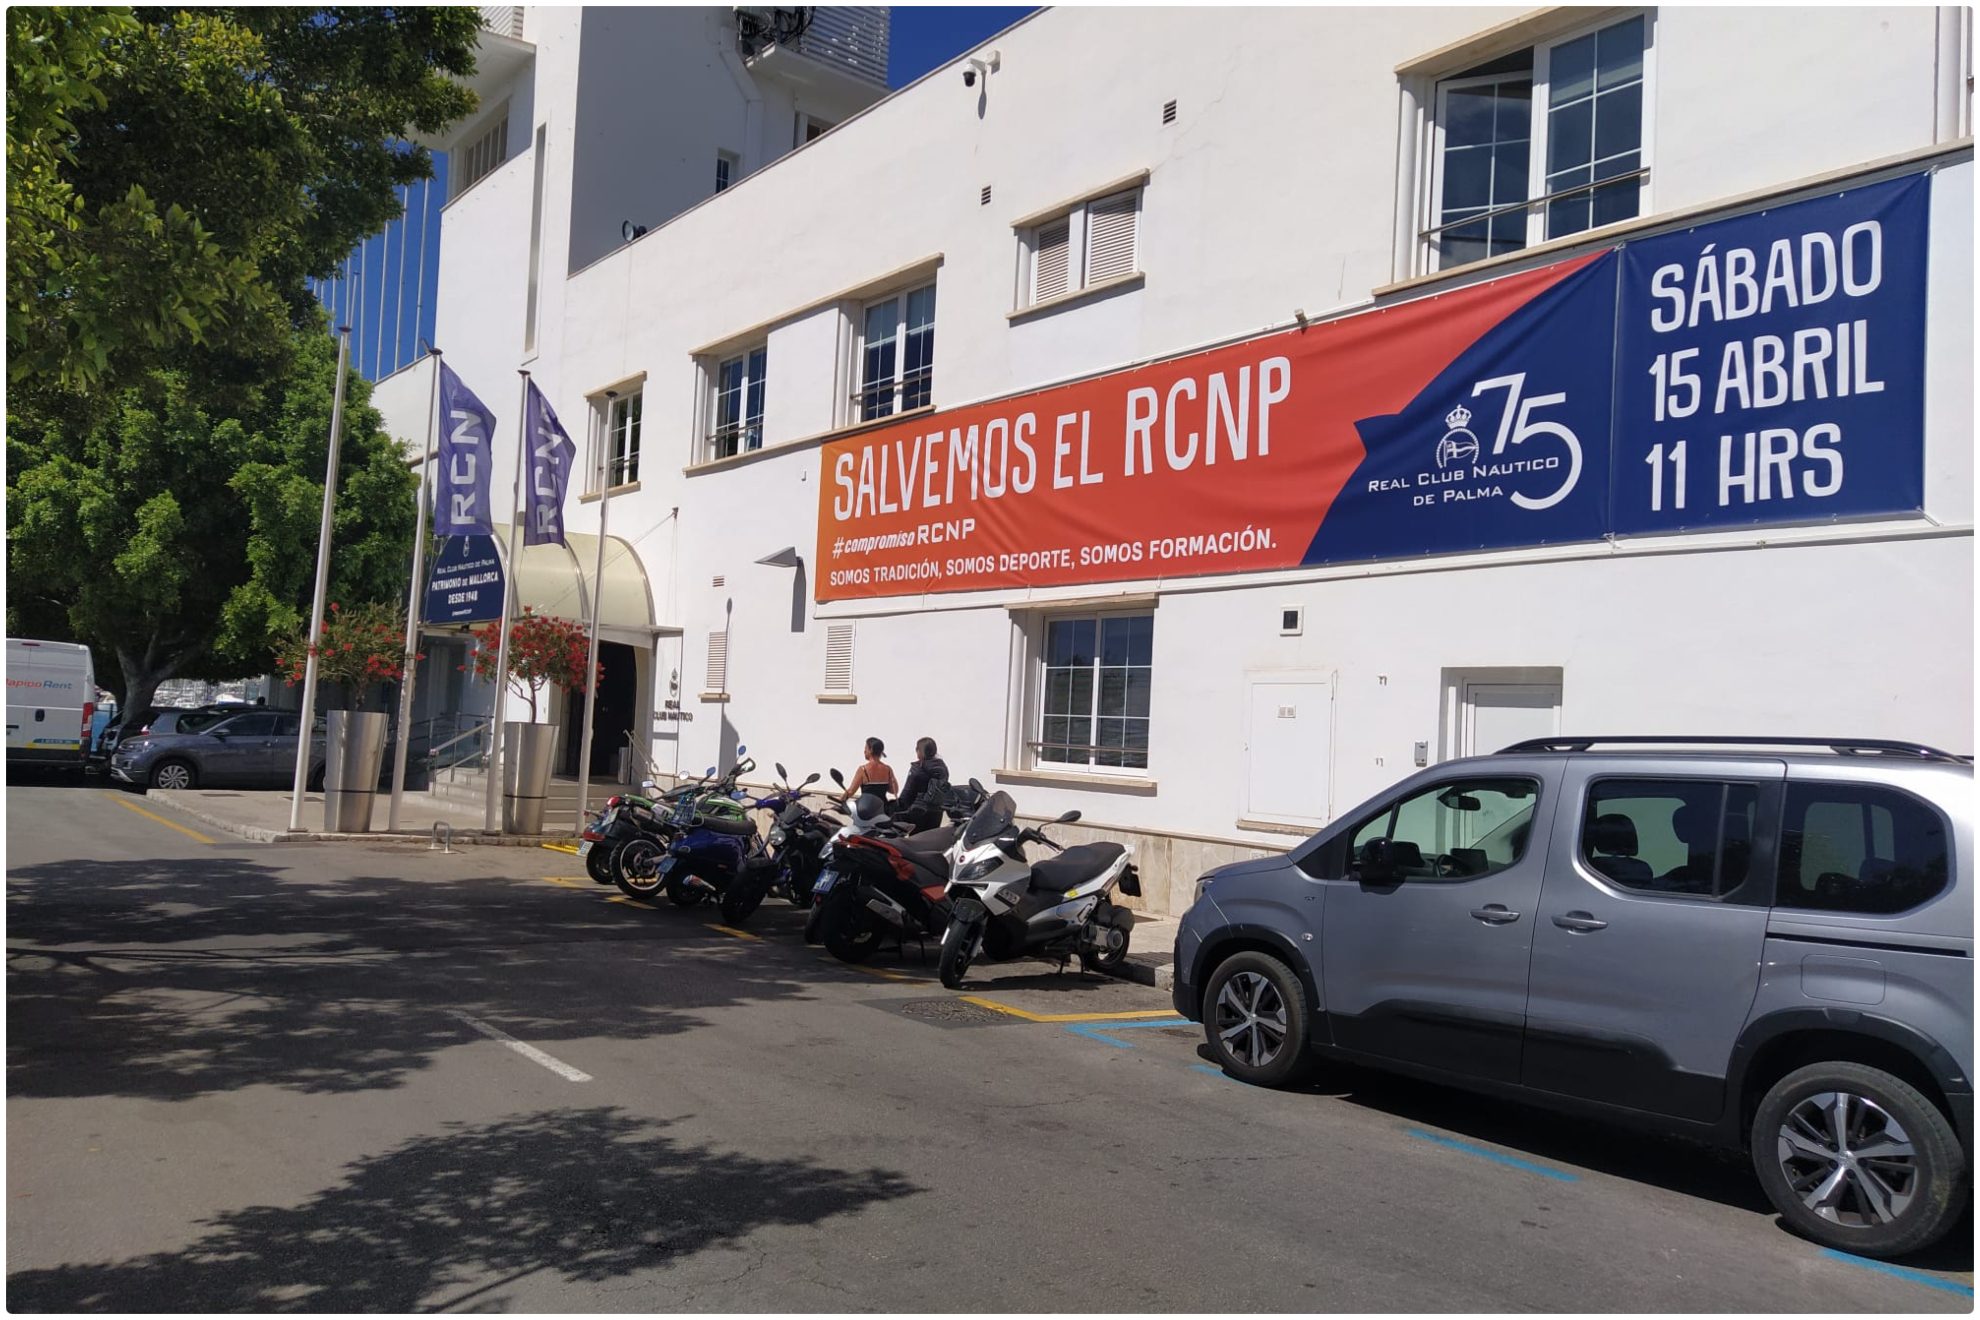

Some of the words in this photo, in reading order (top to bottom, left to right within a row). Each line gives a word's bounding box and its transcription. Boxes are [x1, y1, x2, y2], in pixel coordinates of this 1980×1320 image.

[1650, 220, 1883, 333] SÁBADO
[1647, 347, 1701, 423] 15
[1714, 319, 1885, 414] ABRIL
[834, 412, 1037, 521] SALVEMOS
[1053, 410, 1103, 489] EL
[1124, 356, 1291, 477] RCNP
[1471, 372, 1582, 510] 75
[1645, 440, 1686, 511] 11
[1718, 423, 1843, 507] HRS
[1368, 478, 1410, 492] REAL
[1418, 469, 1464, 486] CLUB
[1413, 494, 1435, 506] DE
[1443, 486, 1503, 503] PALMA
[432, 578, 461, 591] PATRIMONIO
[469, 571, 498, 585] MALLORCA
[830, 569, 870, 586] SOMOS
[874, 559, 942, 582] TRADICIÓN,
[946, 557, 995, 576] SOMOS
[1000, 549, 1075, 572] DEPORTE,
[1080, 541, 1143, 566] SOMOS
[1150, 525, 1277, 559] FORMACIÓN.
[448, 592, 465, 604] DESDE
[665, 700, 680, 709] REAL
